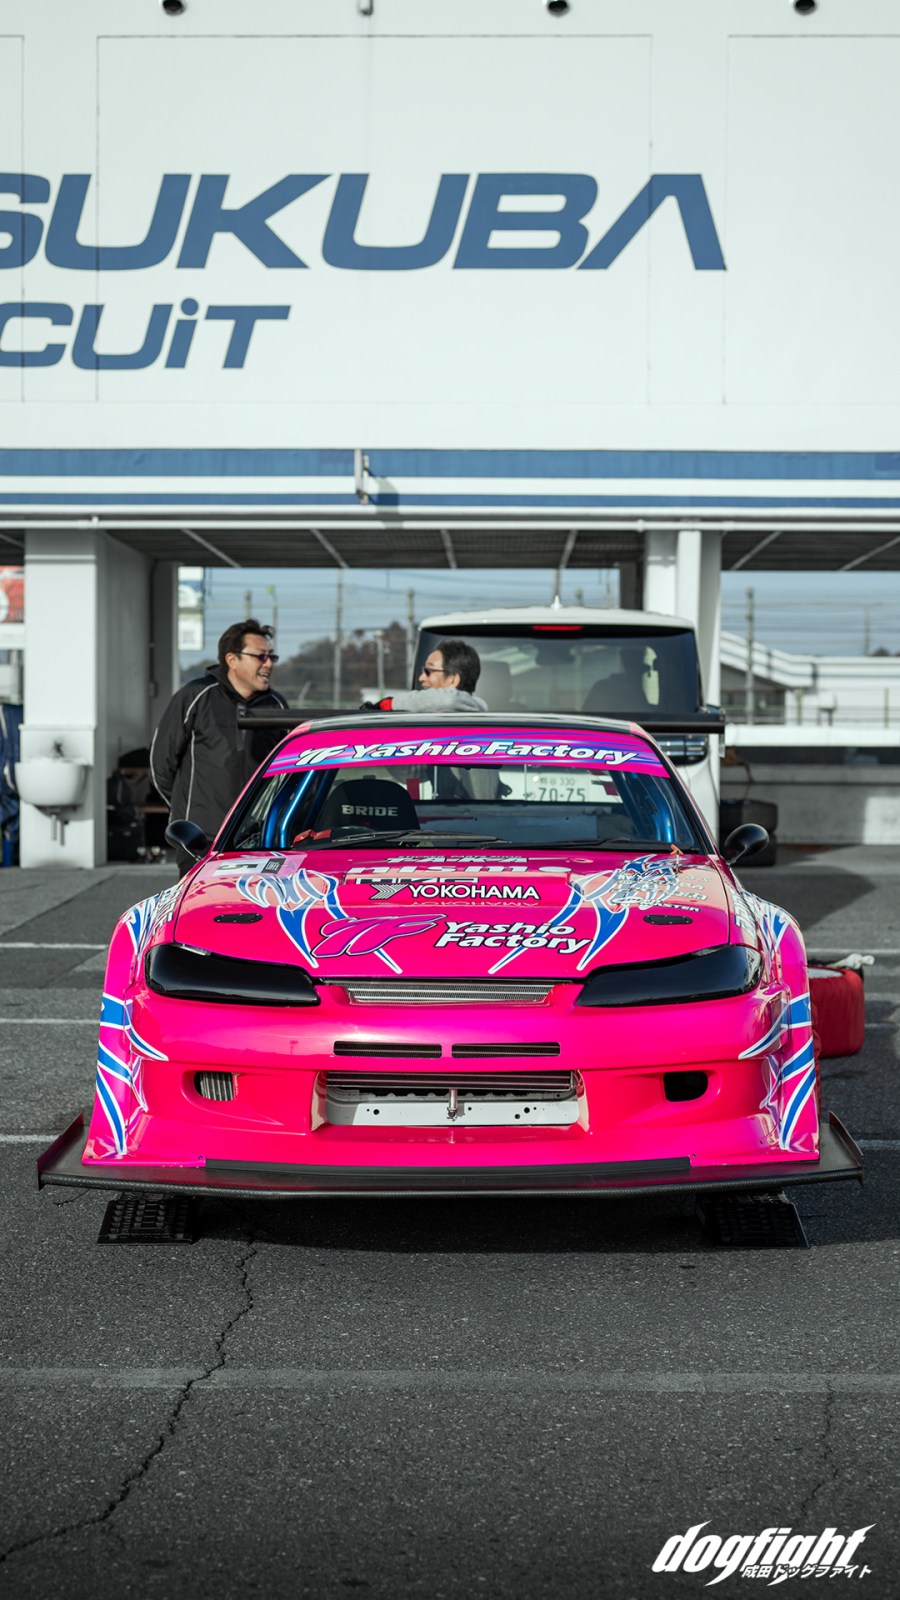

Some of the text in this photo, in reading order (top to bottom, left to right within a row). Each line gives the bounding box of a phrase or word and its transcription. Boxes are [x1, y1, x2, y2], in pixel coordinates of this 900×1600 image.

[349, 741, 484, 762] Yashio
[483, 741, 640, 766] Factory
[341, 804, 399, 818] BRIDE
[409, 884, 541, 901] YOKOHAMA
[444, 921, 576, 936] Yashio
[434, 932, 593, 954] Factory
